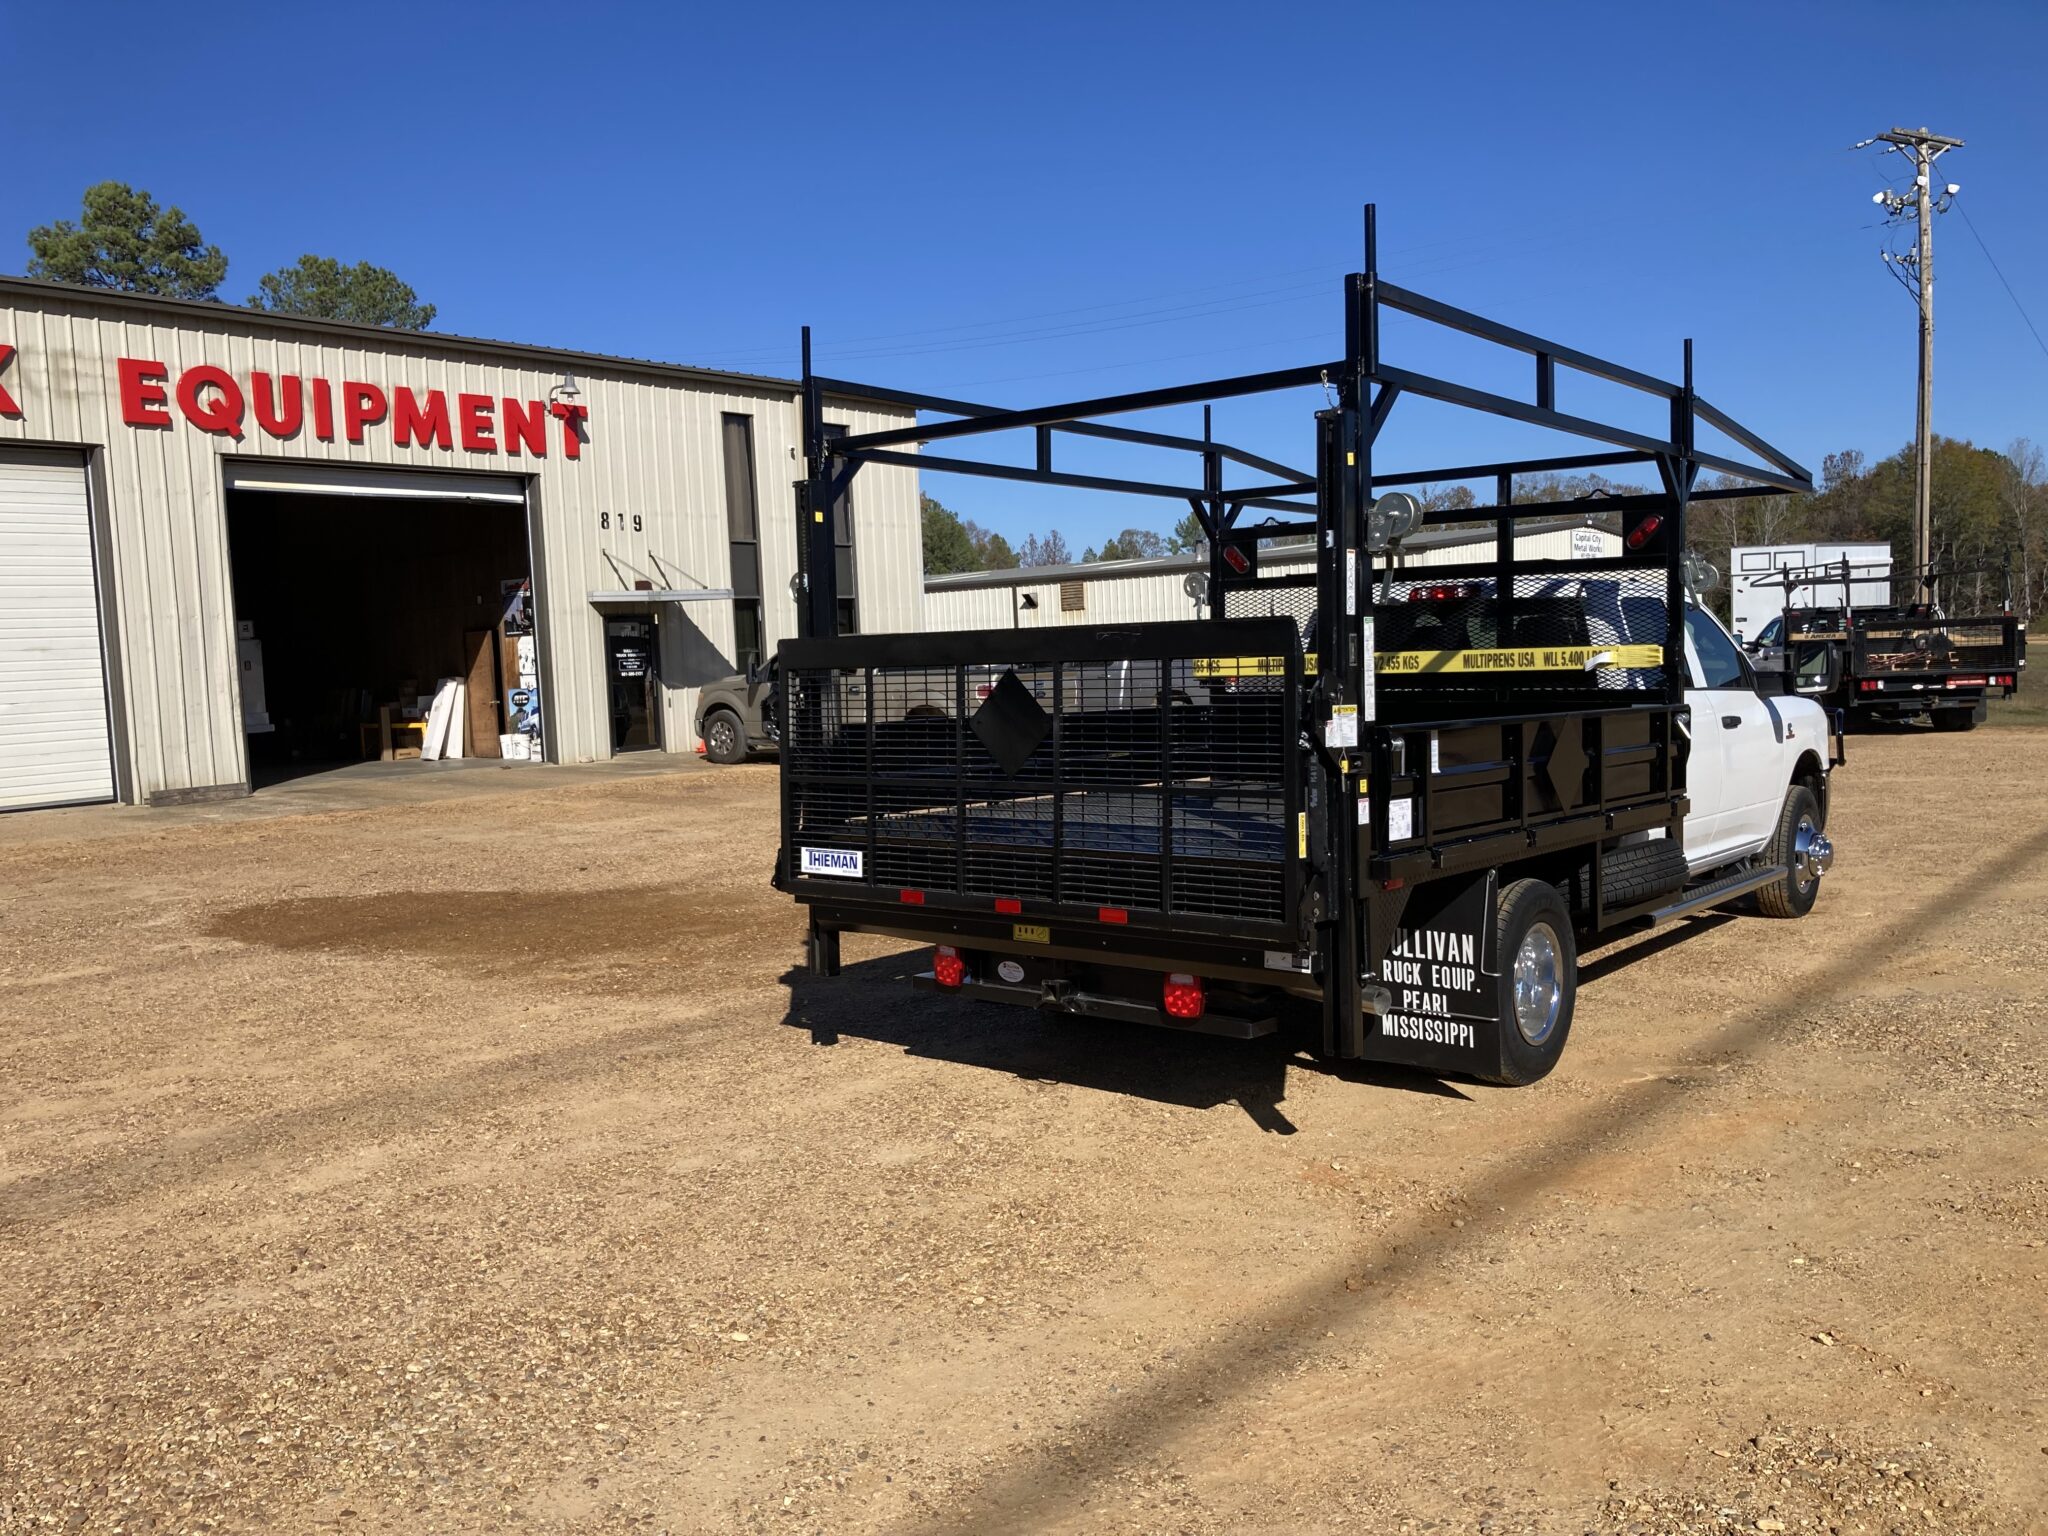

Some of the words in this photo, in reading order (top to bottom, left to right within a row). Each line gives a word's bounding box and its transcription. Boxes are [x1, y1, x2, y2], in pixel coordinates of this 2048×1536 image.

[117, 357, 588, 460] EQUIPMENT
[601, 511, 642, 532] 819
[1574, 543, 1587, 552] Metal
[1592, 534, 1602, 544] City
[1402, 655, 1420, 670] KGS
[1463, 653, 1515, 669] MULTIPRENS
[1518, 652, 1535, 668] USA
[1543, 651, 1559, 667] WLL
[1561, 650, 1584, 666] 5.400
[805, 848, 858, 870] THIEMAN
[1391, 927, 1474, 966] ULLIVAN
[1382, 959, 1423, 986] RUCK
[1431, 964, 1481, 993] EQUIP.
[1403, 989, 1451, 1018] PEARL
[1382, 1014, 1474, 1049] MISSISSIPPI
